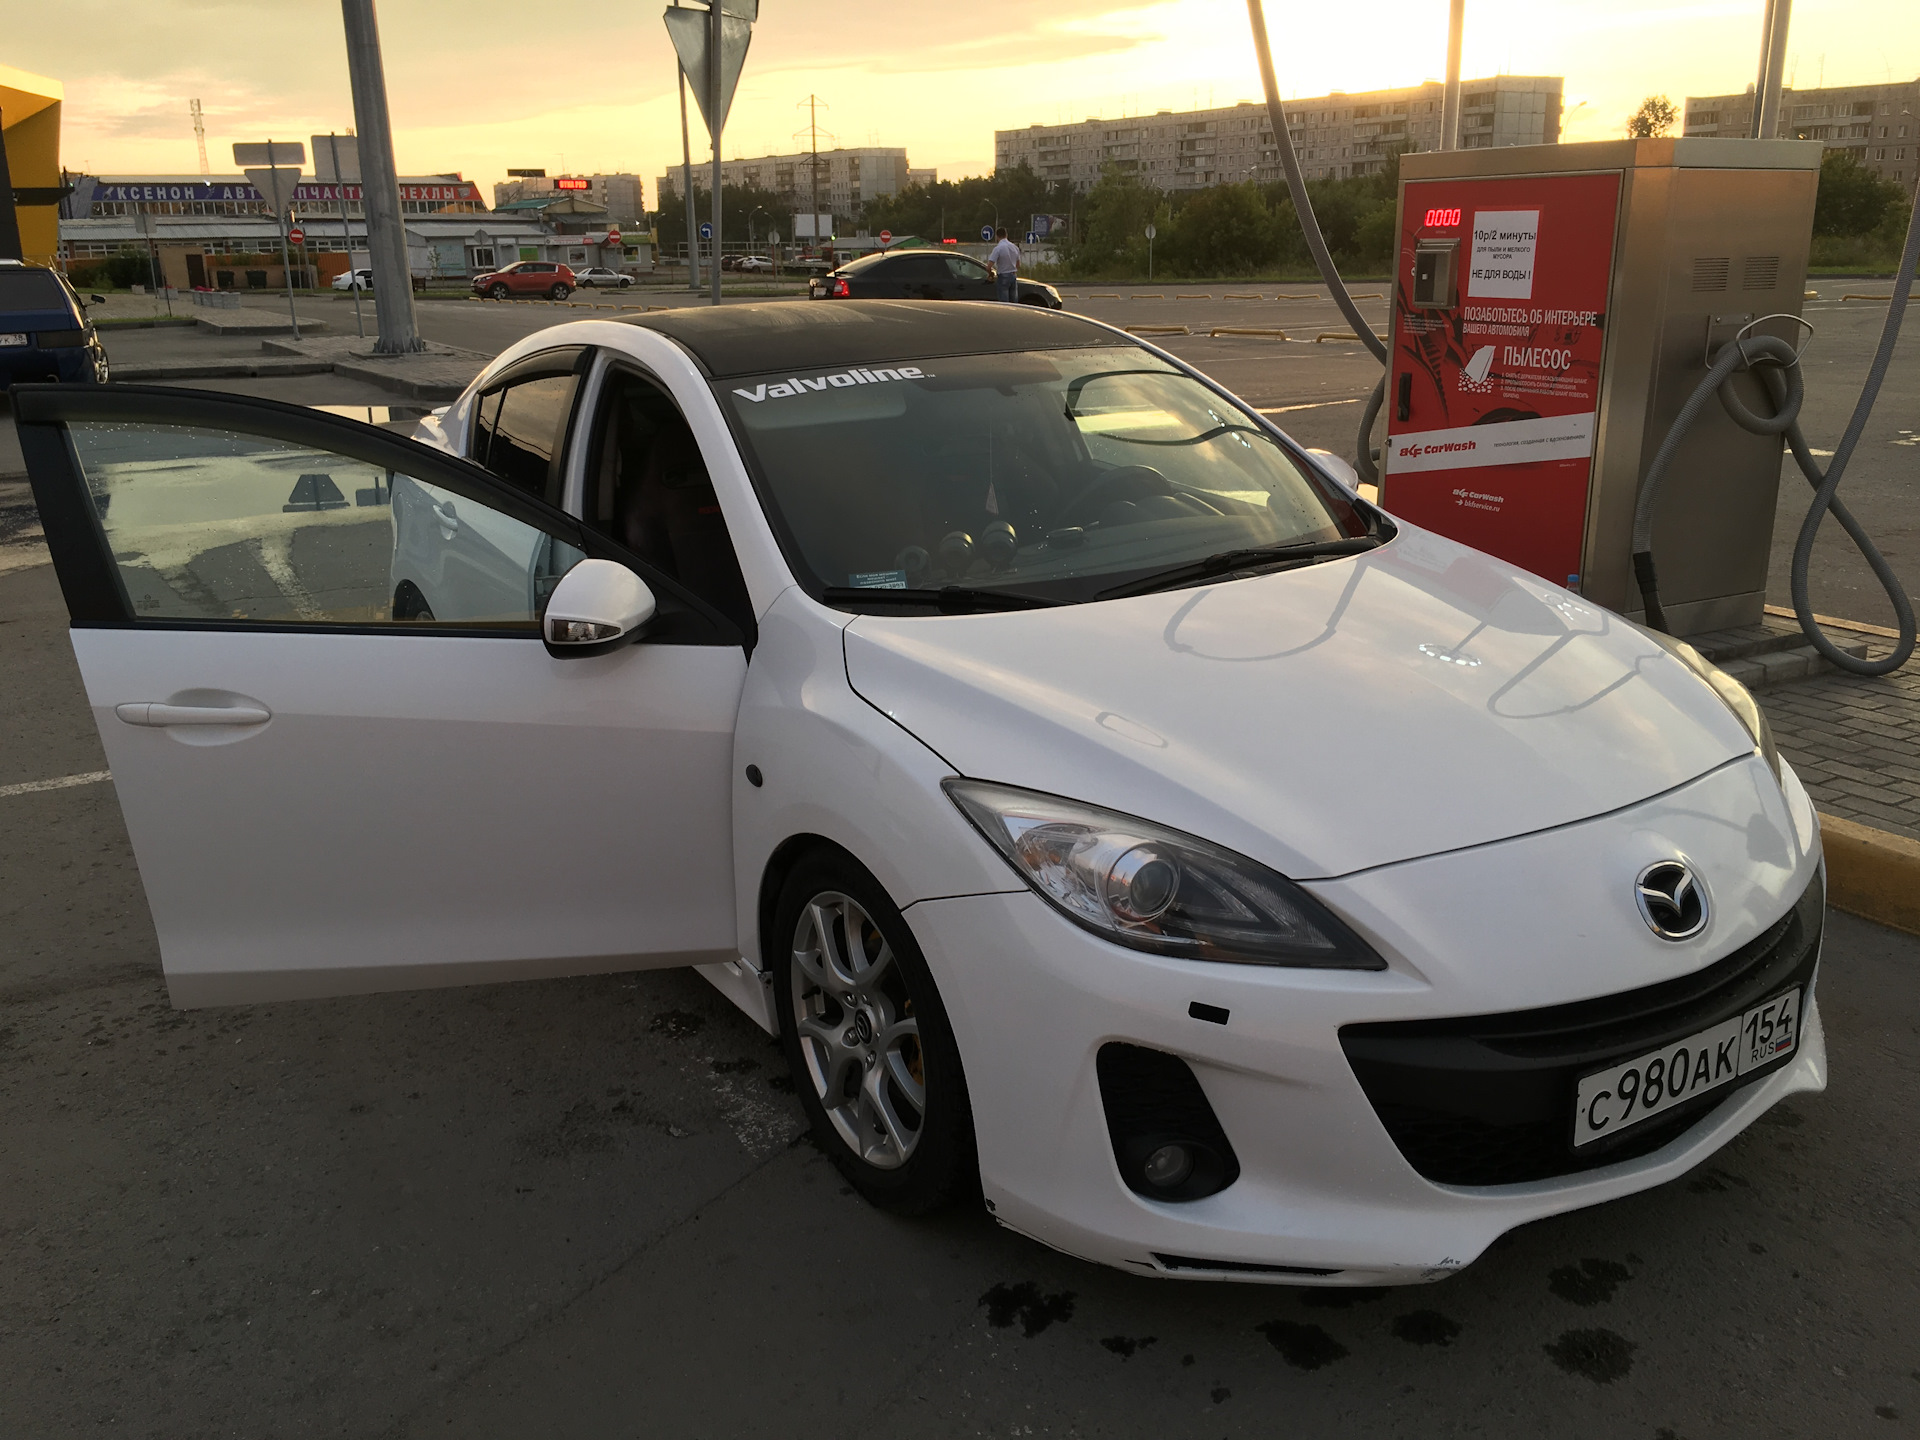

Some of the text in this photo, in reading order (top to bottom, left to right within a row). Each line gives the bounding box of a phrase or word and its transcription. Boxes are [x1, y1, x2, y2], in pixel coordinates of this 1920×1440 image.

[117, 187, 195, 199] КСЕНОН
[1425, 209, 1461, 226] 0000
[1474, 230, 1537, 242] 10р/2 минуты
[1472, 270, 1483, 278] НЕ
[1484, 270, 1501, 280] ДЛЯ
[1503, 270, 1527, 280] ВОДЫ
[1464, 306, 1597, 326] ПОЗАБОТЬТЕСЬ ОБ ИНТЕРЬЕРЕ
[1463, 324, 1487, 334] ВАШЕГО
[1488, 325, 1530, 337] АВТОМОБИЛЯ
[1503, 346, 1571, 370] ПЫЛЕСОС
[732, 366, 925, 403] Valvoline
[1424, 440, 1476, 454] CarWash
[1469, 491, 1504, 503] CarWash
[1464, 500, 1501, 512] bkfservice.ru
[1745, 998, 1792, 1049] 154
[1751, 1041, 1775, 1063] RUS
